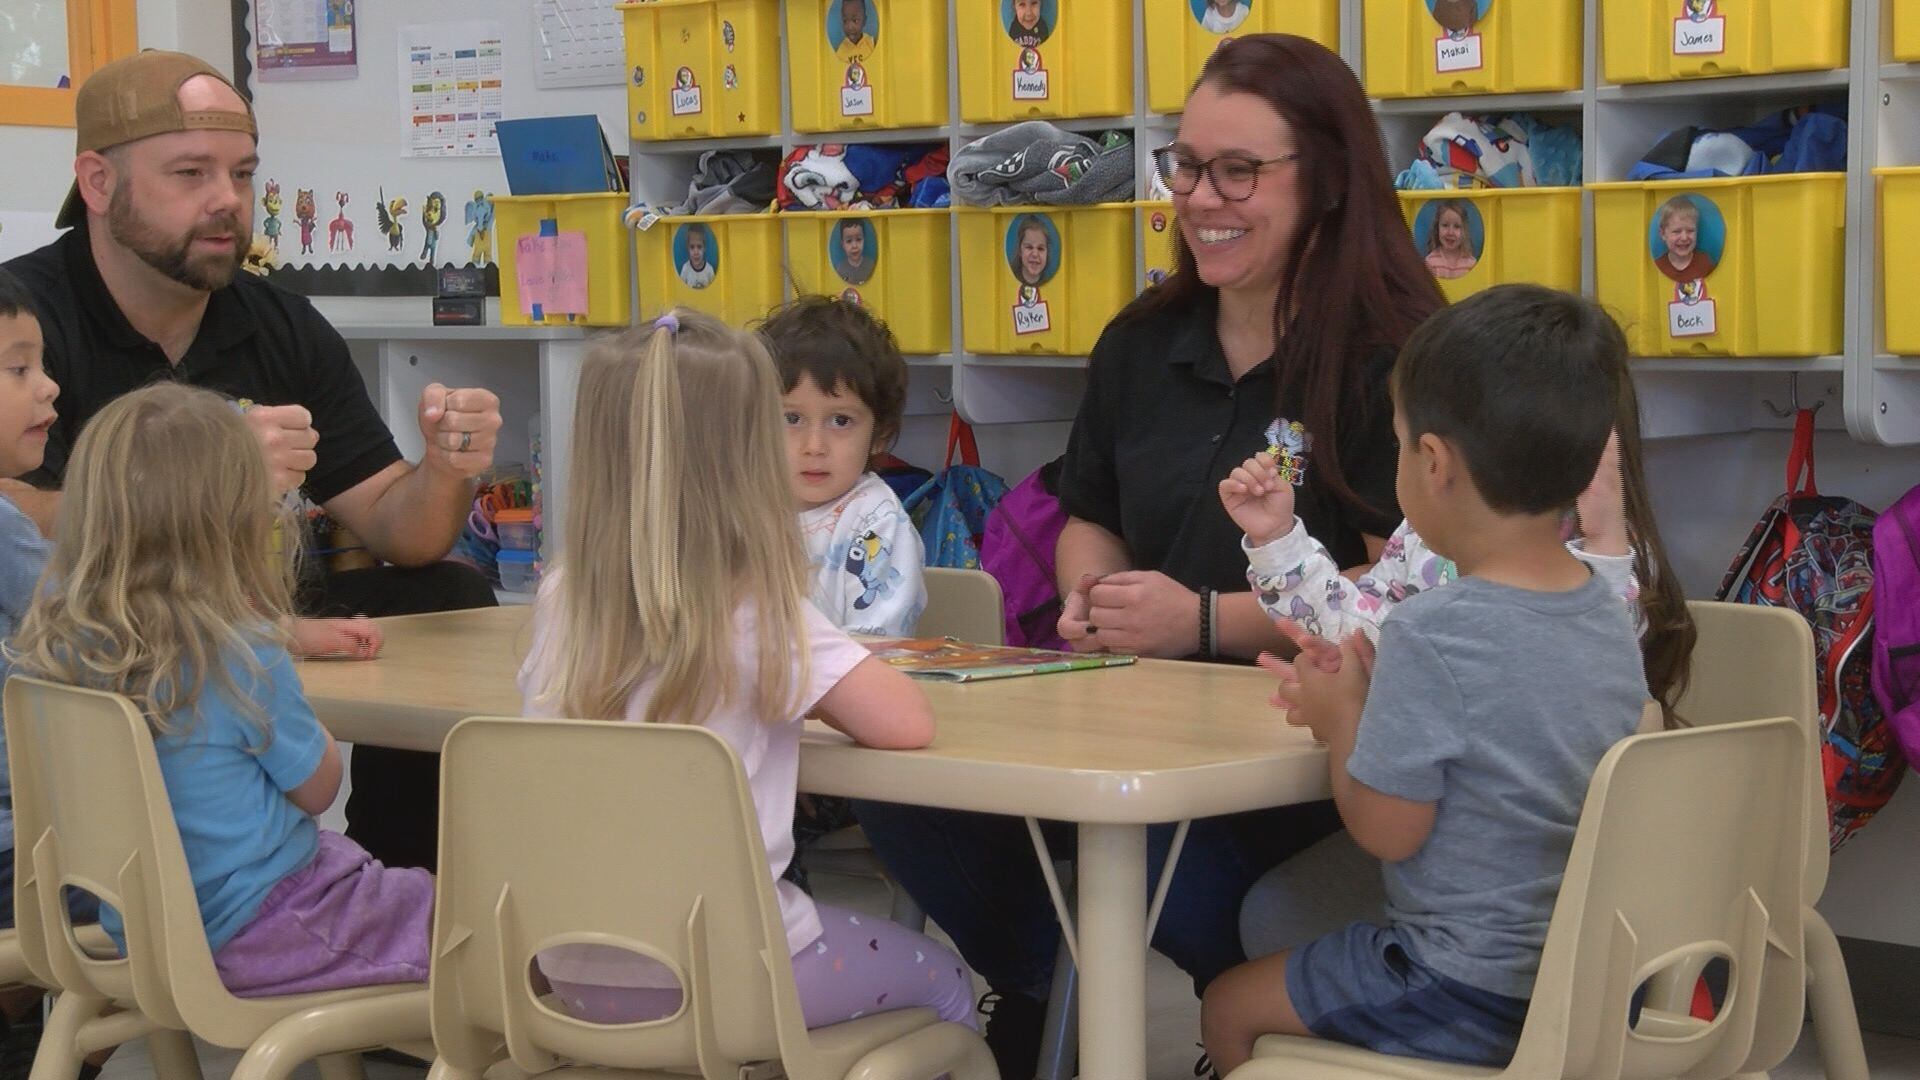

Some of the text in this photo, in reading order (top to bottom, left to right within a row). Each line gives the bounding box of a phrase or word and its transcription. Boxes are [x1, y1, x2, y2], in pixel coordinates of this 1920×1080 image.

[1680, 31, 1713, 46] James
[1017, 76, 1046, 97] Kennedy
[1017, 311, 1044, 328] Ryker
[1677, 314, 1704, 328] Beck
